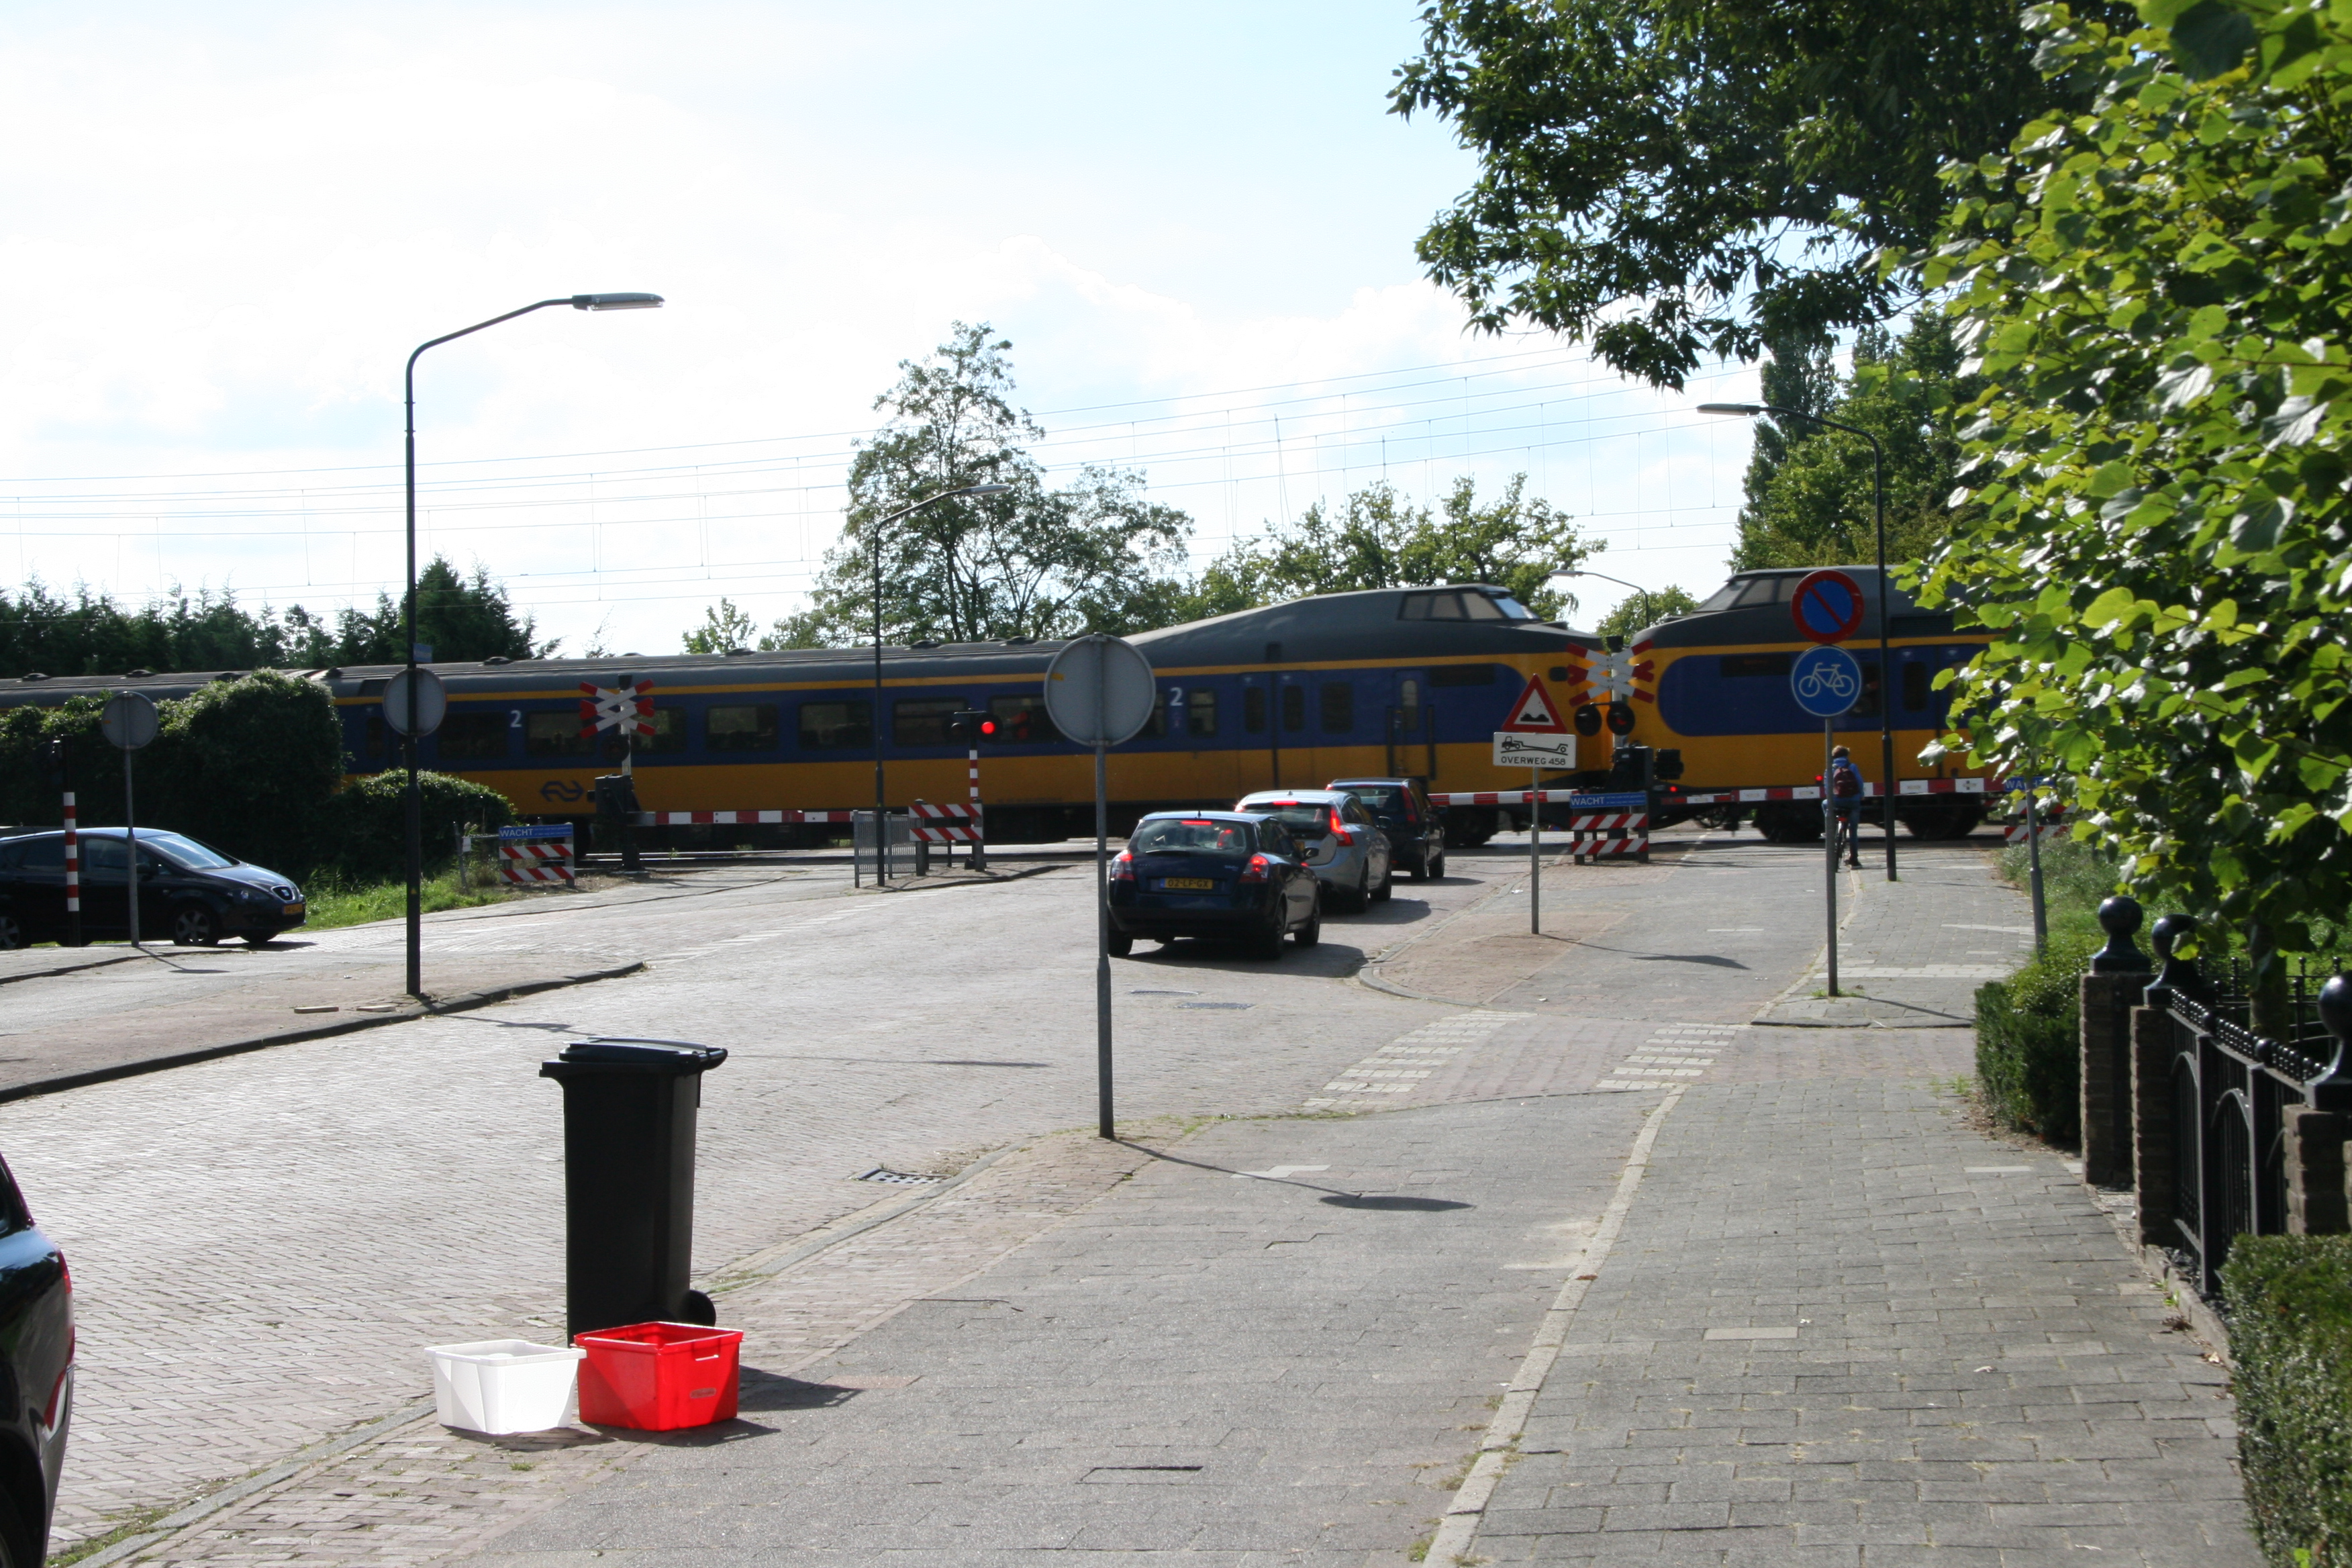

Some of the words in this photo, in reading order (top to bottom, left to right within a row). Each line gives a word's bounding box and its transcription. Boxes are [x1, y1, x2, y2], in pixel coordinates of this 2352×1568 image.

[1171, 687, 1183, 706] 2
[510, 710, 522, 728] 2
[1501, 756, 1546, 765] OVERWEG
[1571, 797, 1605, 805] WACHT
[499, 829, 533, 837] WACHT
[1168, 879, 1208, 888] 02-LF-GX
